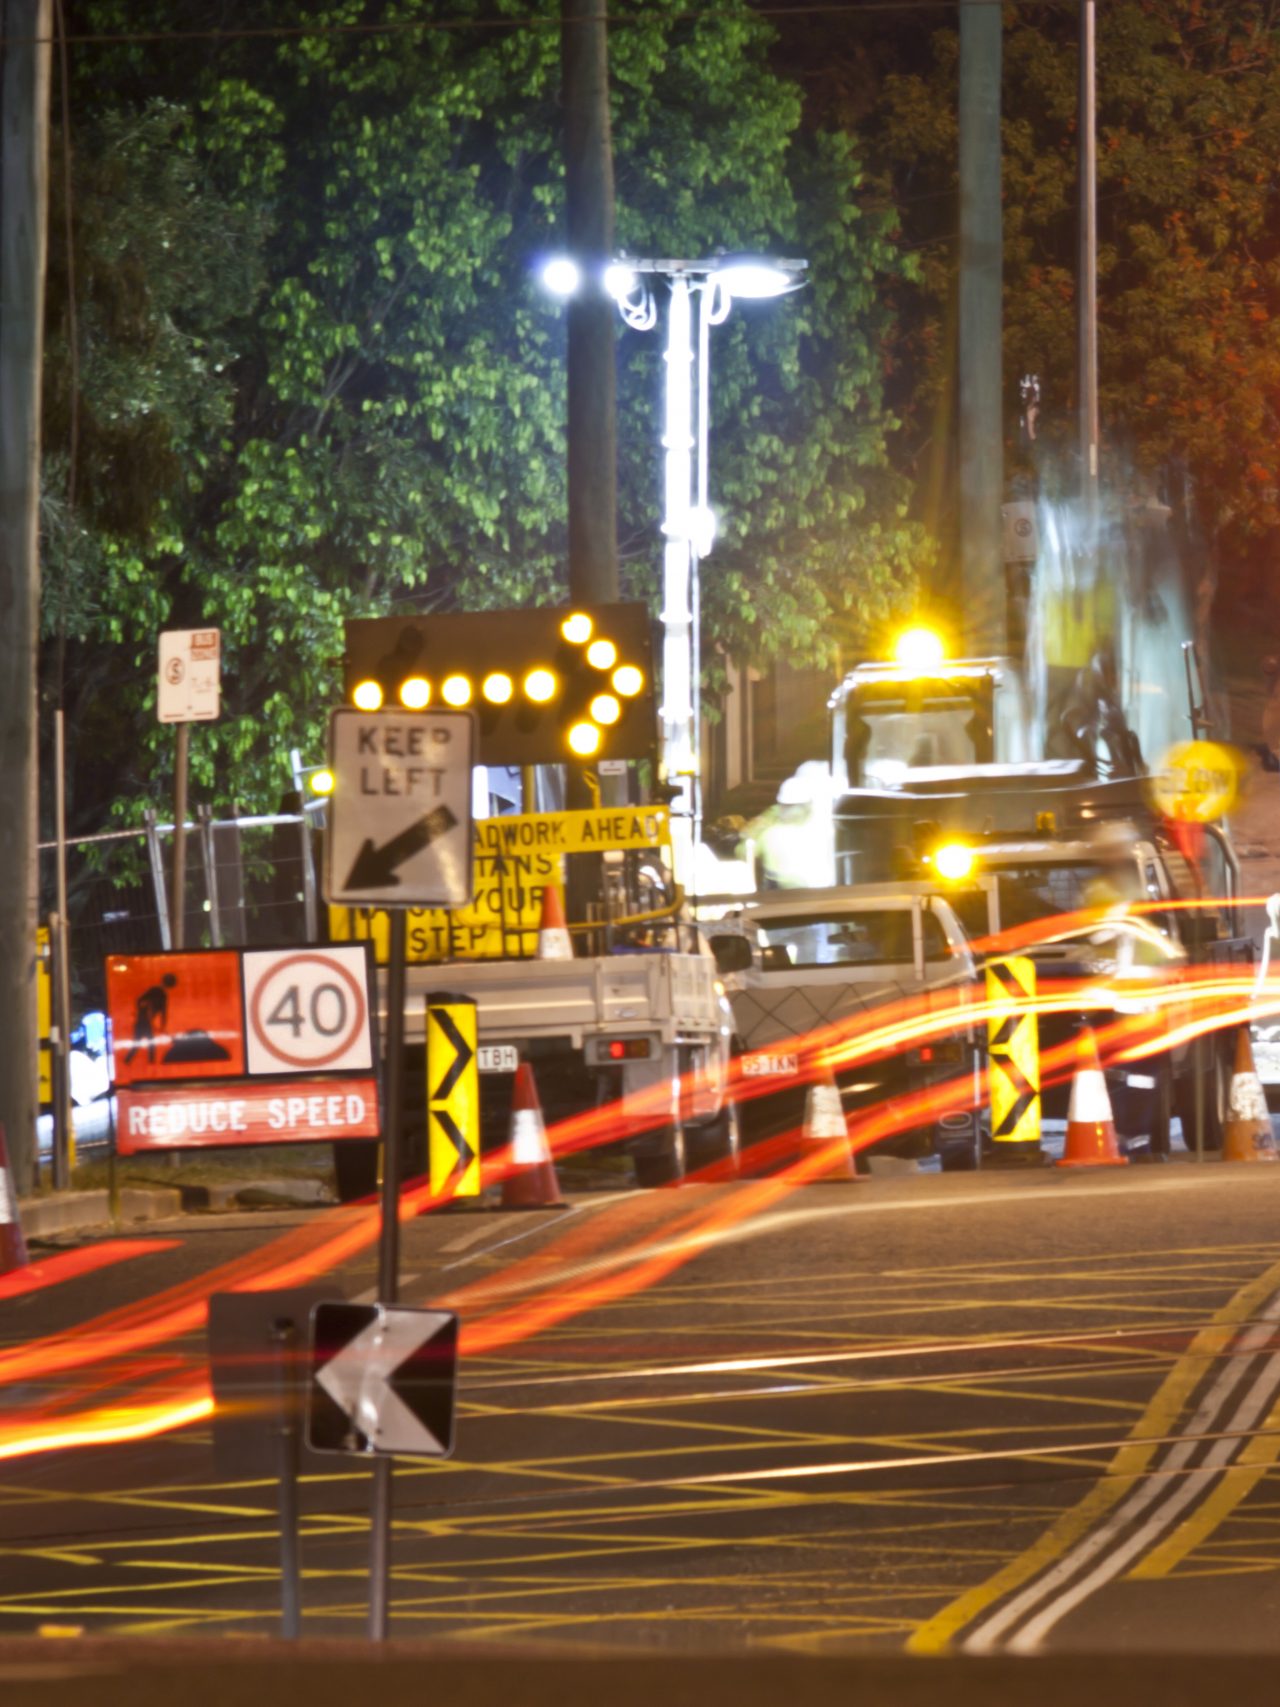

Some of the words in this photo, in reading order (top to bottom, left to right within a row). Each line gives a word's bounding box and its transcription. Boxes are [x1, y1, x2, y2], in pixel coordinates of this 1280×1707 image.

[357, 726, 453, 757] KEEP
[360, 767, 447, 796] LEFT
[473, 821, 567, 849] ADWORK
[580, 814, 661, 843] AHEAD
[410, 925, 488, 953] STEP
[265, 983, 348, 1038] 40
[128, 1101, 248, 1136] REDUCE
[267, 1095, 366, 1130] SPEED
